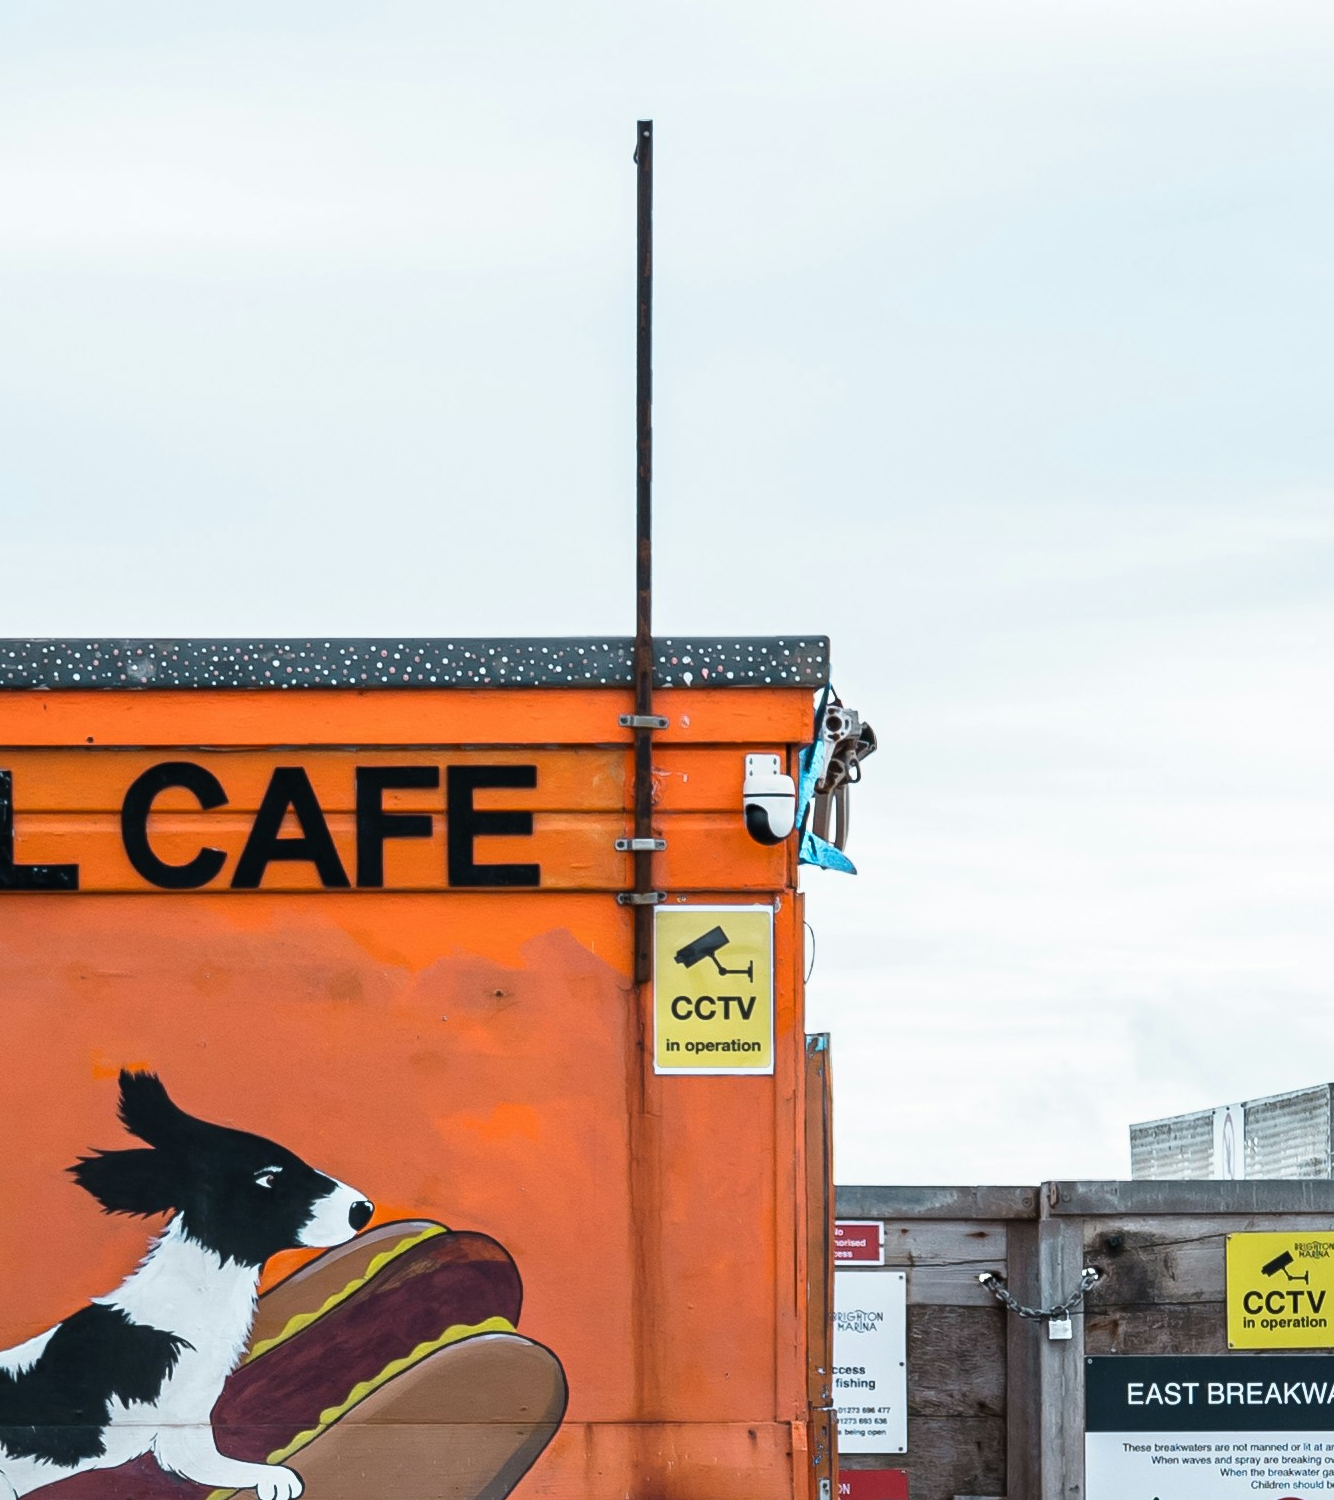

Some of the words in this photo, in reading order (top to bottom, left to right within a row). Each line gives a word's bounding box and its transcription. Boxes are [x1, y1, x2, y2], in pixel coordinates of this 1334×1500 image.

[120, 760, 543, 890] CAFE
[670, 995, 758, 1021] CCTV
[666, 1038, 681, 1052] in
[684, 1038, 762, 1055] operation
[1293, 1240, 1334, 1252] BRIGHTON
[1298, 1249, 1331, 1260] MARINA
[1243, 1290, 1327, 1315] CCTV
[837, 1321, 878, 1333] MARINA
[1243, 1316, 1256, 1329] in
[1260, 1315, 1328, 1332] operation
[835, 1377, 876, 1391] fishing
[1127, 1382, 1200, 1406] EAST
[1122, 1442, 1152, 1453] These
[1154, 1443, 1212, 1453] breakwaters
[1214, 1444, 1230, 1452] are
[1232, 1443, 1248, 1452] not
[1250, 1443, 1289, 1452] manned
[1290, 1444, 1301, 1452] or
[1313, 1443, 1323, 1452] at
[1151, 1455, 1180, 1465] When
[1181, 1457, 1212, 1465] waves
[1214, 1455, 1233, 1465] and
[1234, 1456, 1261, 1466] spray
[1263, 1456, 1279, 1464] are
[1281, 1455, 1322, 1467] breaking
[1219, 1467, 1248, 1477] When
[1250, 1468, 1266, 1477] the
[1267, 1468, 1321, 1477] breakwater
[1250, 1480, 1291, 1490] Children
[1292, 1480, 1325, 1490] should
